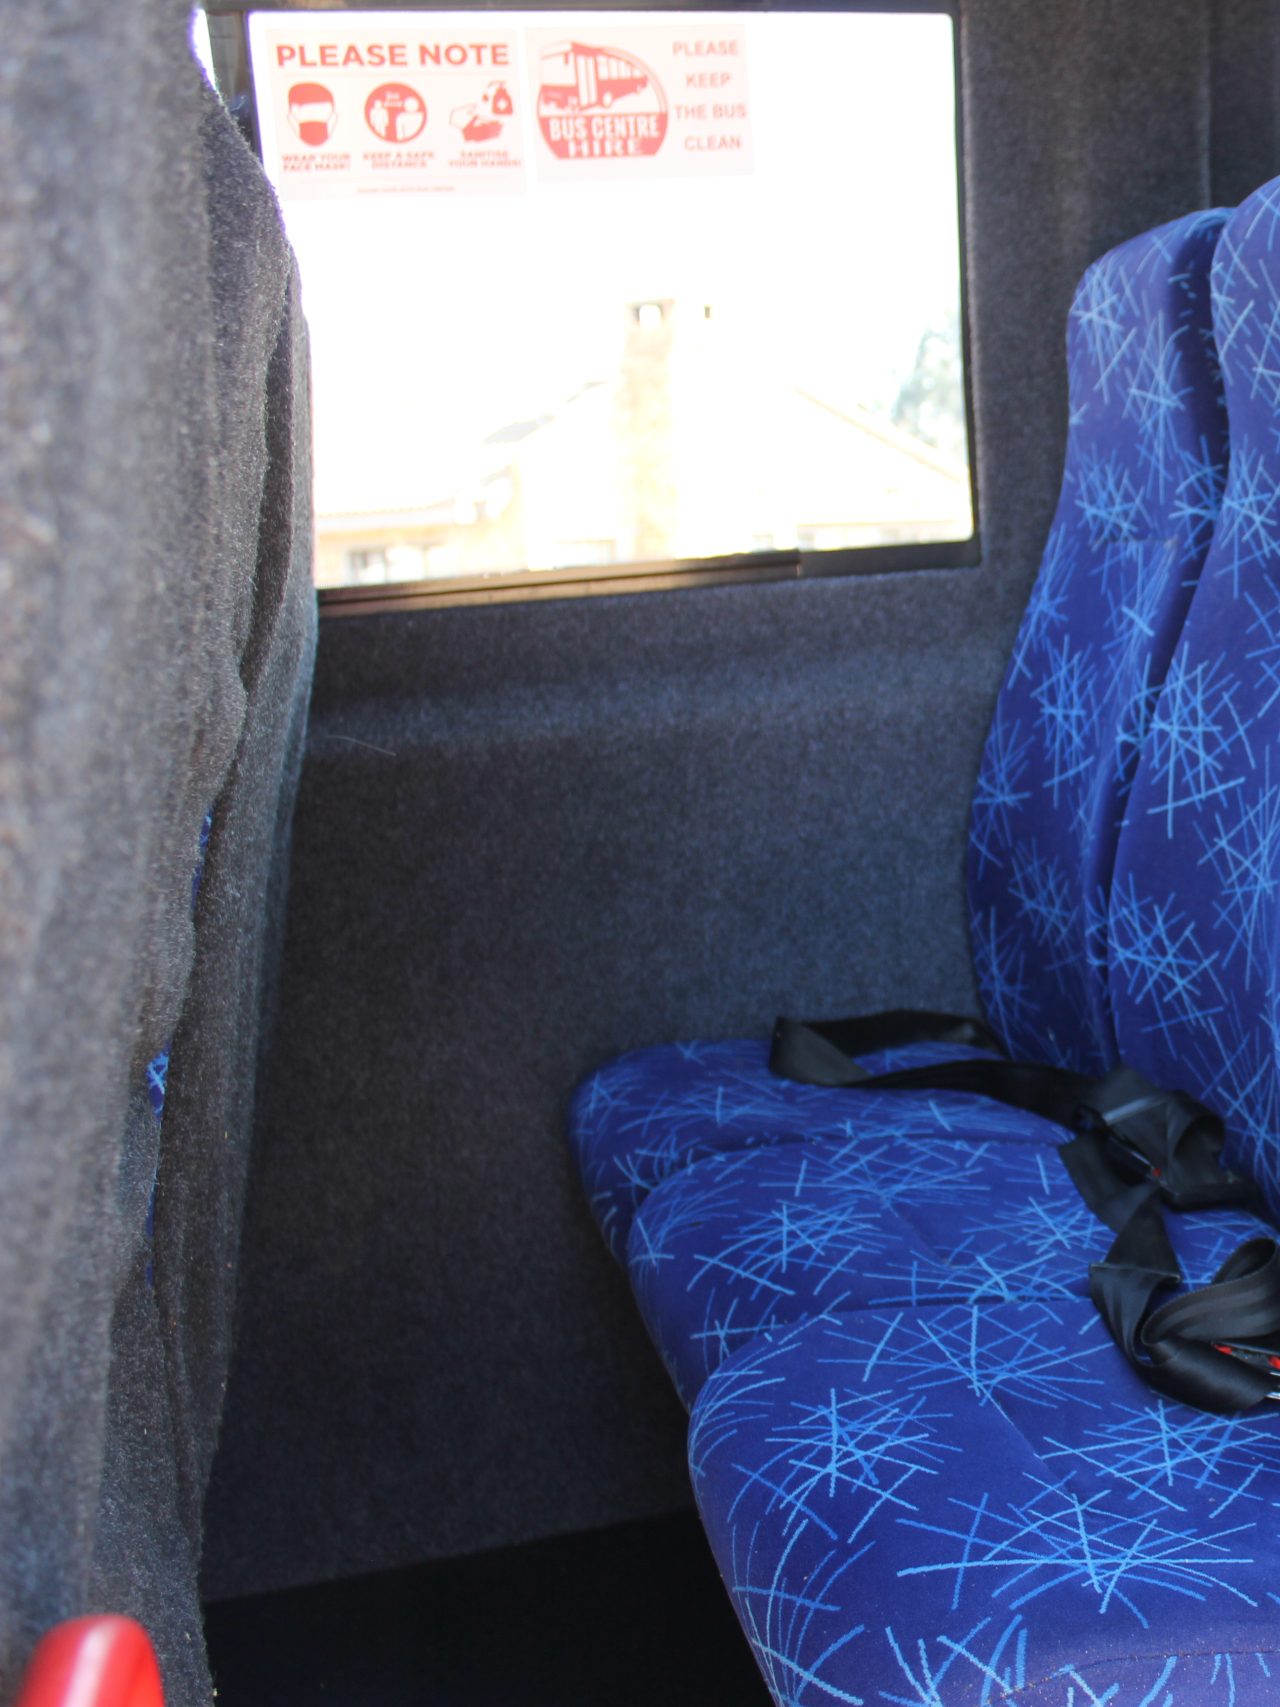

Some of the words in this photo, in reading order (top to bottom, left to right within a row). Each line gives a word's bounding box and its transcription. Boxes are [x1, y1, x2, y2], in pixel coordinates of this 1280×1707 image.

[276, 43, 408, 68] PLEASE
[419, 43, 510, 66] NOTE
[672, 40, 738, 56] PLEASE
[685, 72, 732, 88] KEEP
[674, 104, 707, 120] THE
[712, 103, 747, 120] BUS
[549, 117, 588, 141] BUS
[591, 114, 660, 139] CENTRE
[684, 135, 741, 152] CLEAN
